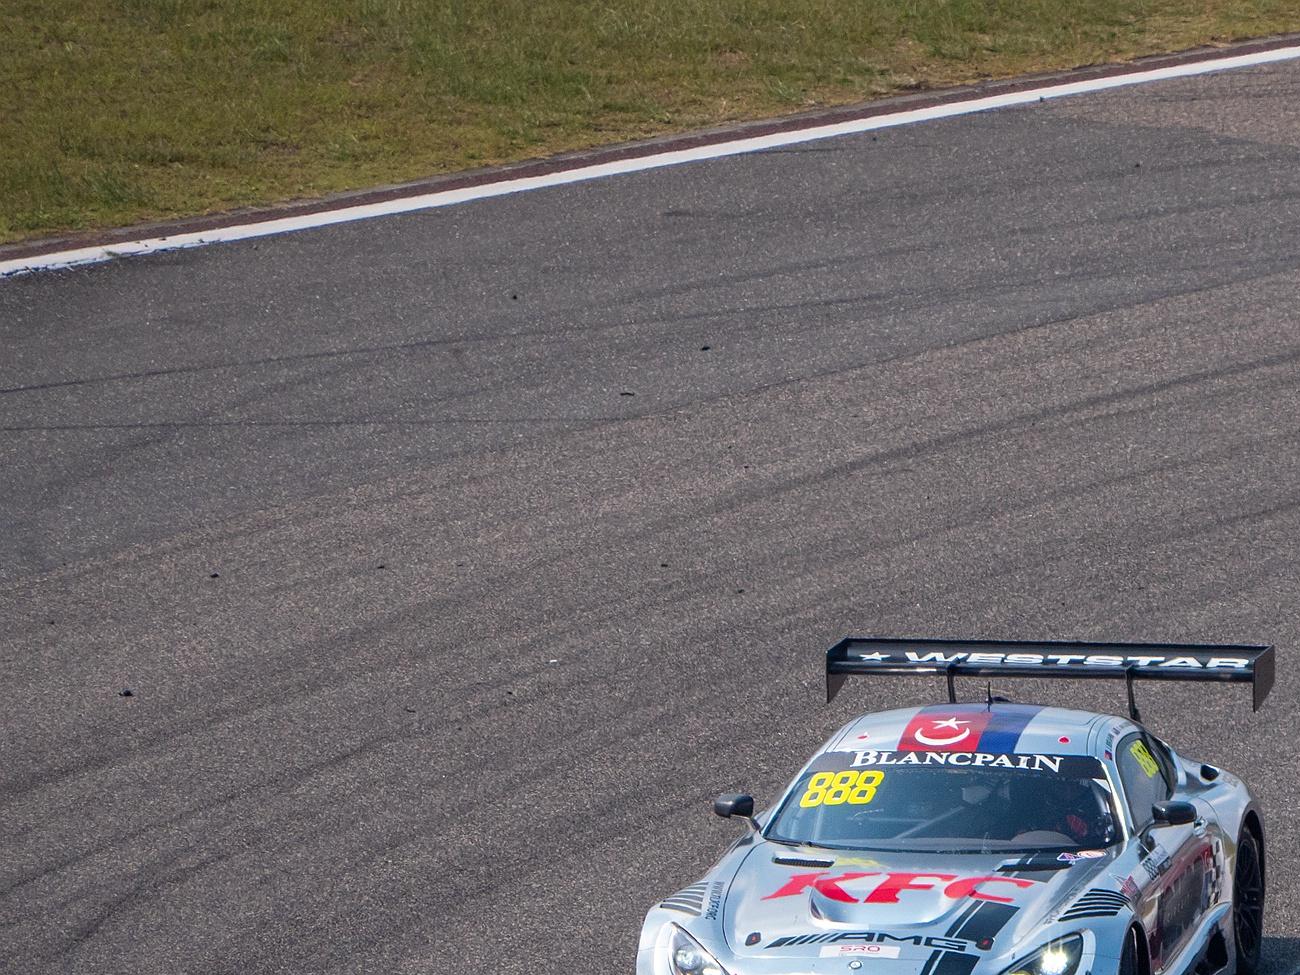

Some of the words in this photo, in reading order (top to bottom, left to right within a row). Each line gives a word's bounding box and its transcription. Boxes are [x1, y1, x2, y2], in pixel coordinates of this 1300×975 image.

[904, 651, 1250, 669] WESTSTAR
[850, 750, 1065, 773] BLANCPAIN
[799, 770, 885, 808] 888
[760, 872, 1035, 904] KFC
[830, 932, 968, 952] AMG
[839, 945, 881, 954] SRO
